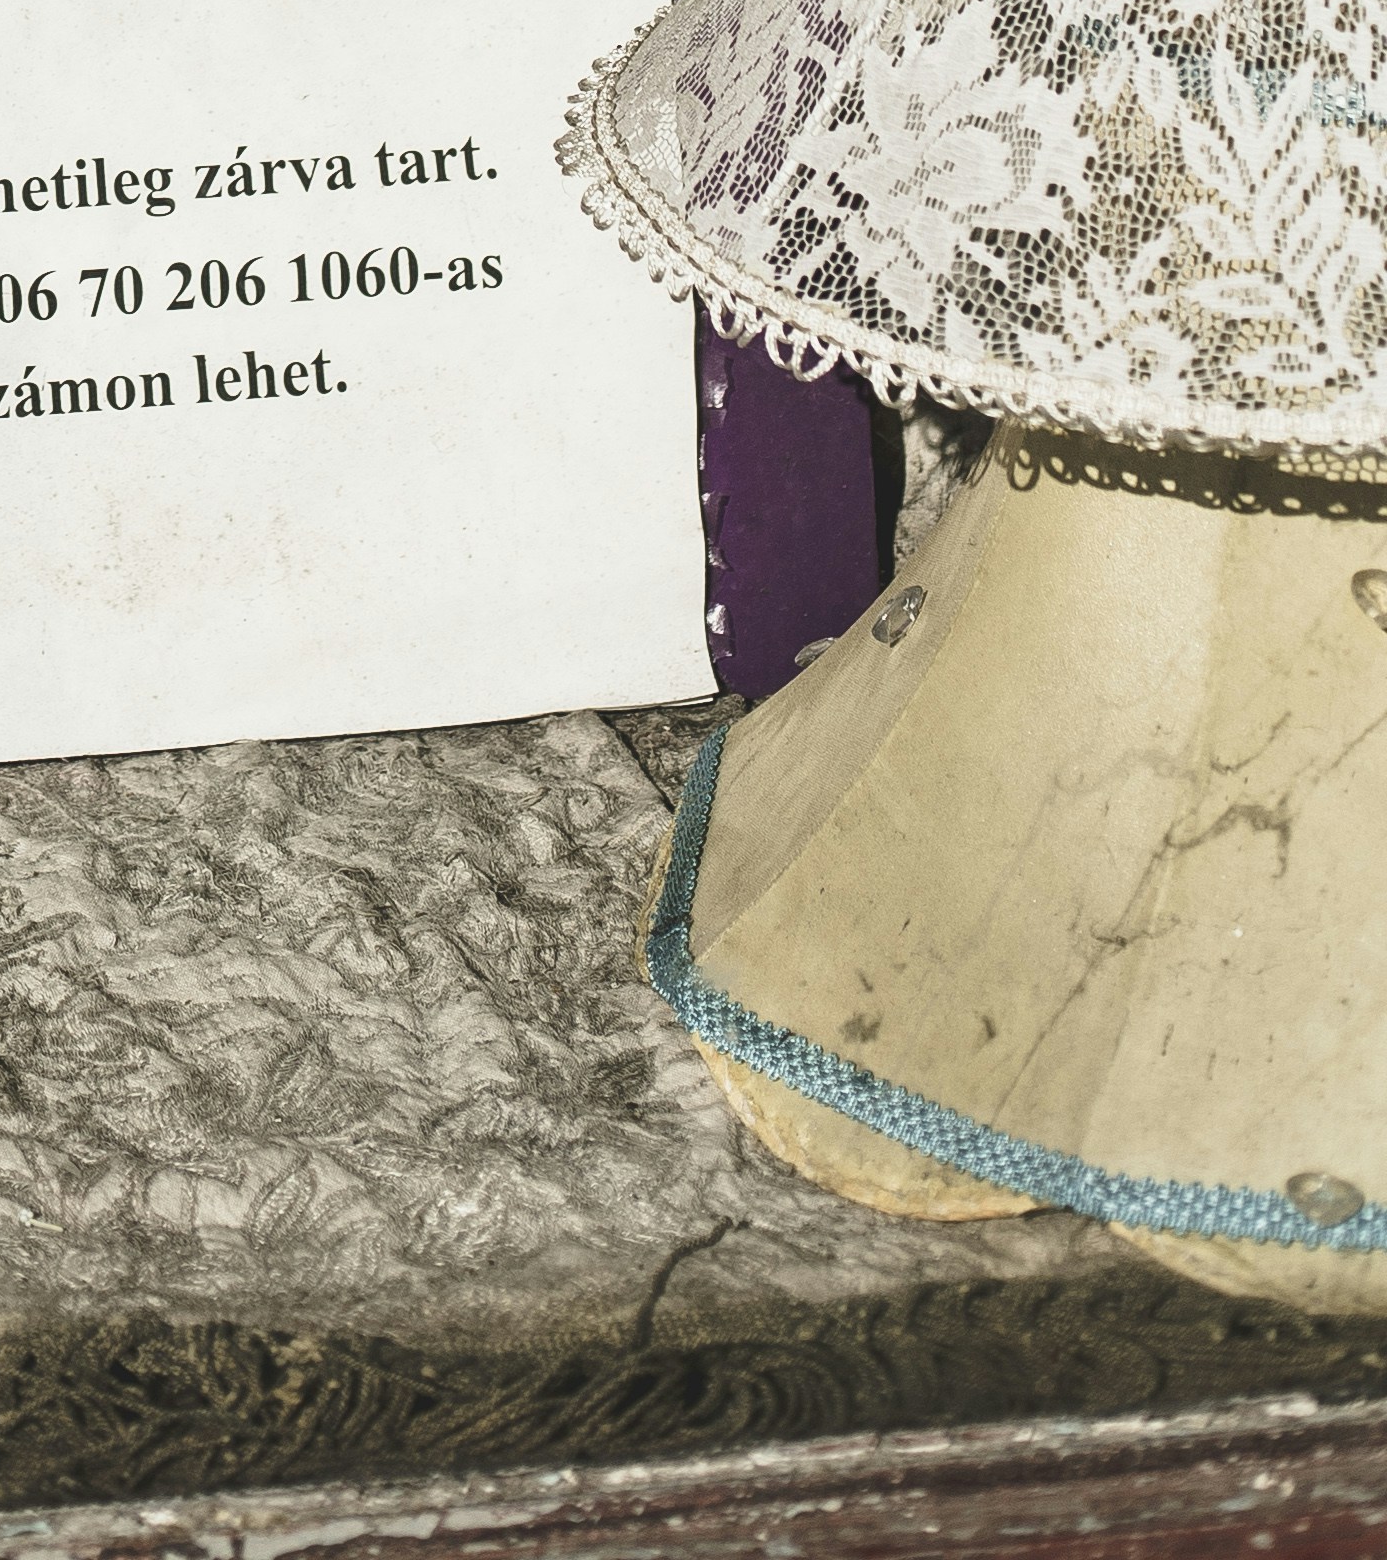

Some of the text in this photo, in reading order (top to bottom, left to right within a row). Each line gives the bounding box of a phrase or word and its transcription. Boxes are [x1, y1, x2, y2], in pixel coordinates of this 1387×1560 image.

[194, 145, 356, 199] zárva
[374, 137, 497, 187] tart.
[79, 265, 144, 318] 70
[165, 257, 266, 312] 206
[290, 246, 503, 303] 1060-as
[194, 350, 347, 404] lehet.
